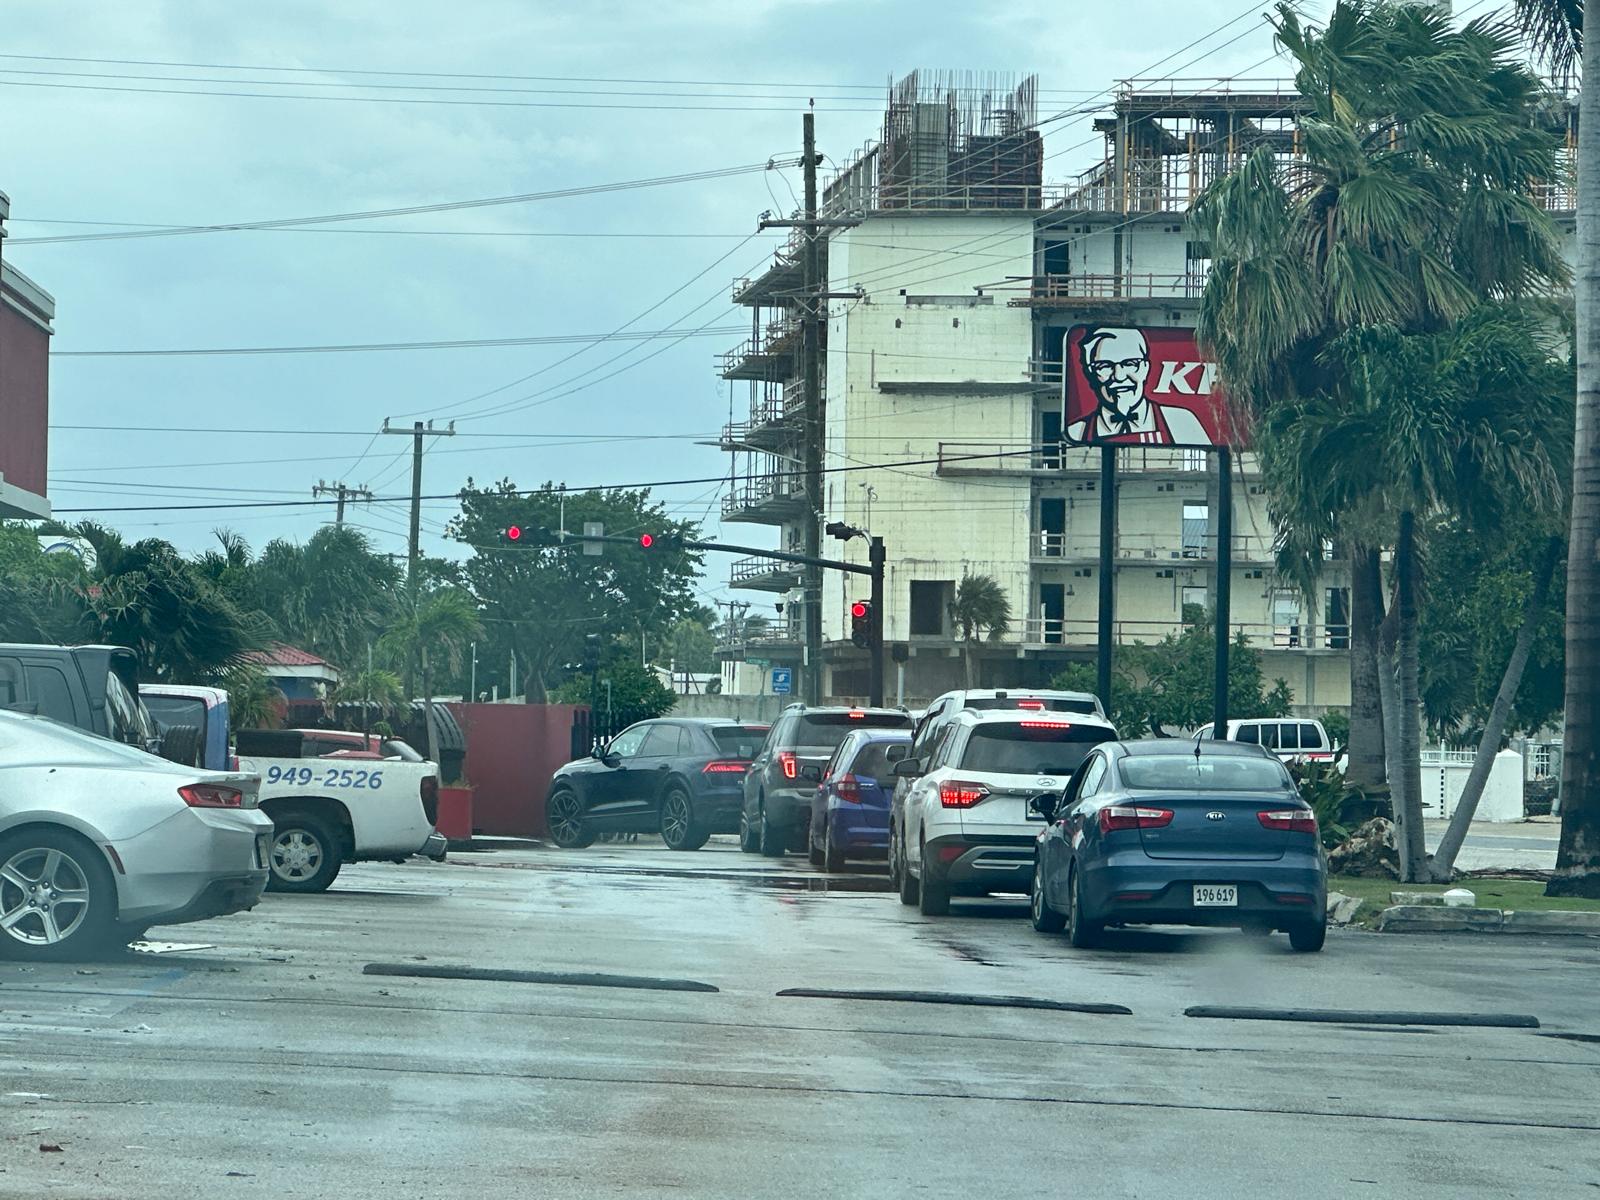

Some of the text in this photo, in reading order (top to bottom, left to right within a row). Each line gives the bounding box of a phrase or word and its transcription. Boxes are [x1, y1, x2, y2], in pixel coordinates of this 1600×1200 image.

[1153, 361, 1218, 395] KF
[266, 766, 384, 790] 949-2526
[1196, 889, 1235, 902] 196 619
